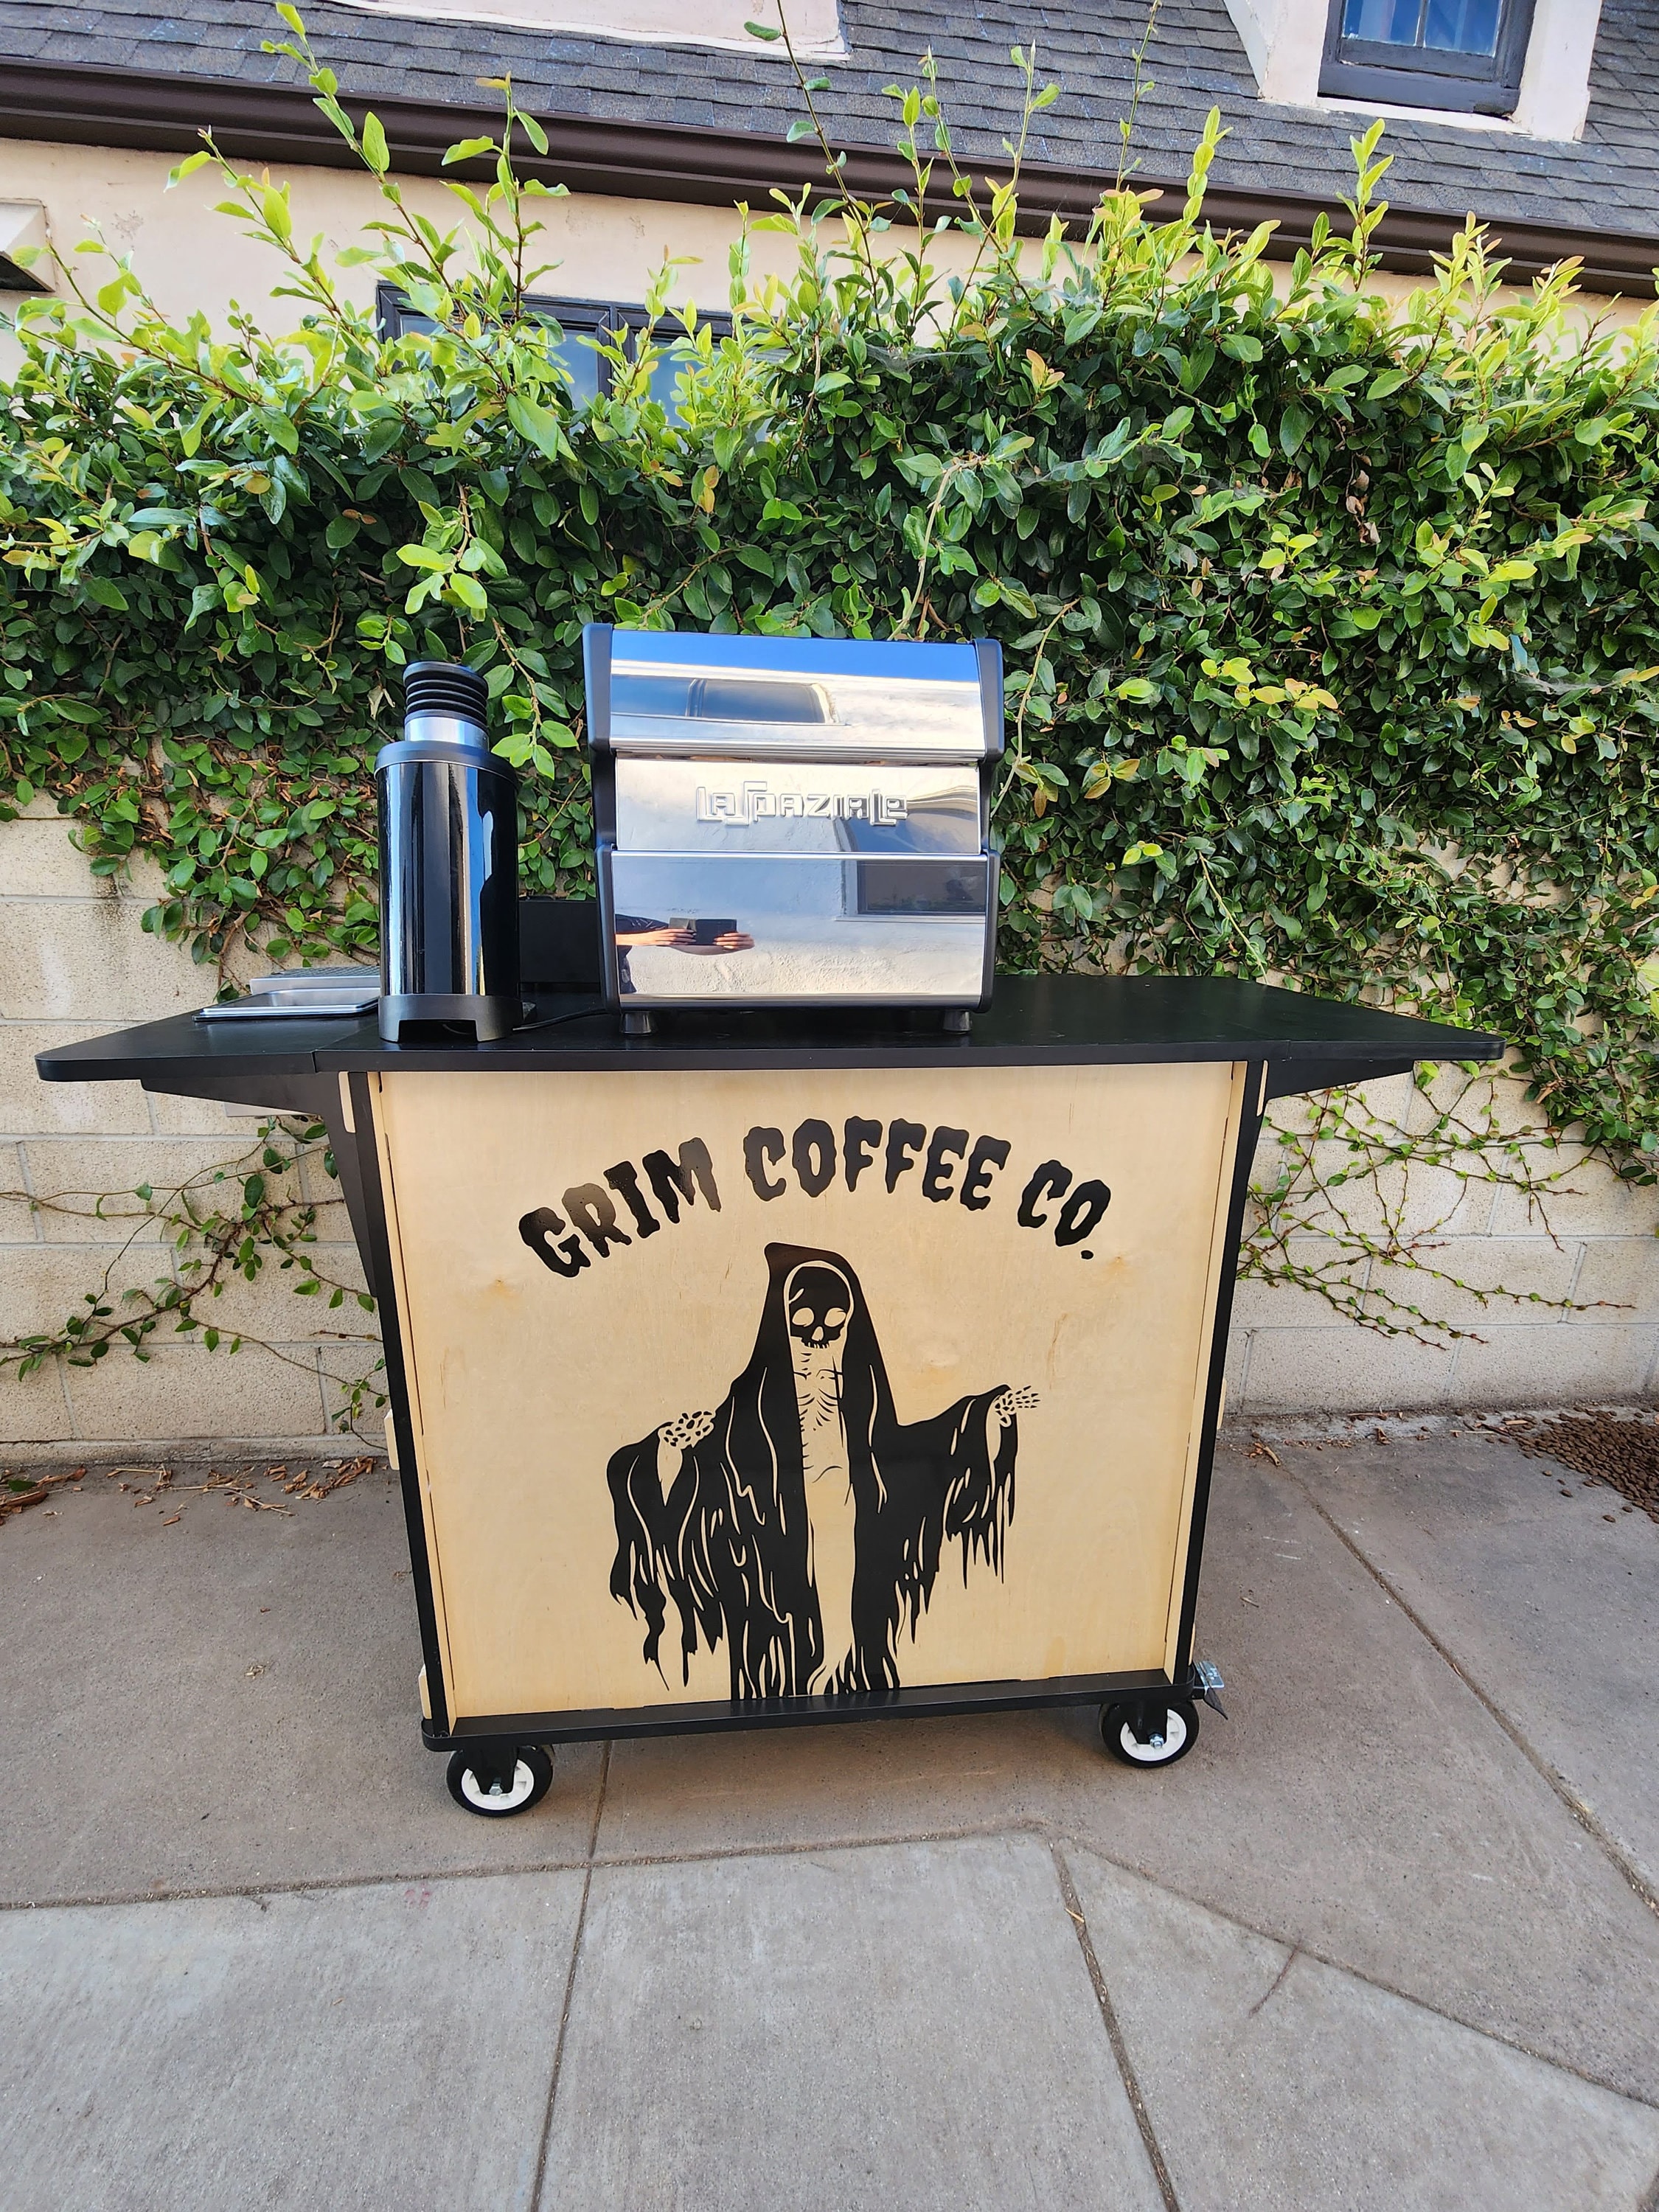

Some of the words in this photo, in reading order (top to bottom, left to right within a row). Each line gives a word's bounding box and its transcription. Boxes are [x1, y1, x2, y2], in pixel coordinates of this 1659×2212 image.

[518, 1137, 722, 1278] GRIM
[742, 1116, 1012, 1211] COFFEE
[1017, 1159, 1111, 1260] CO.
